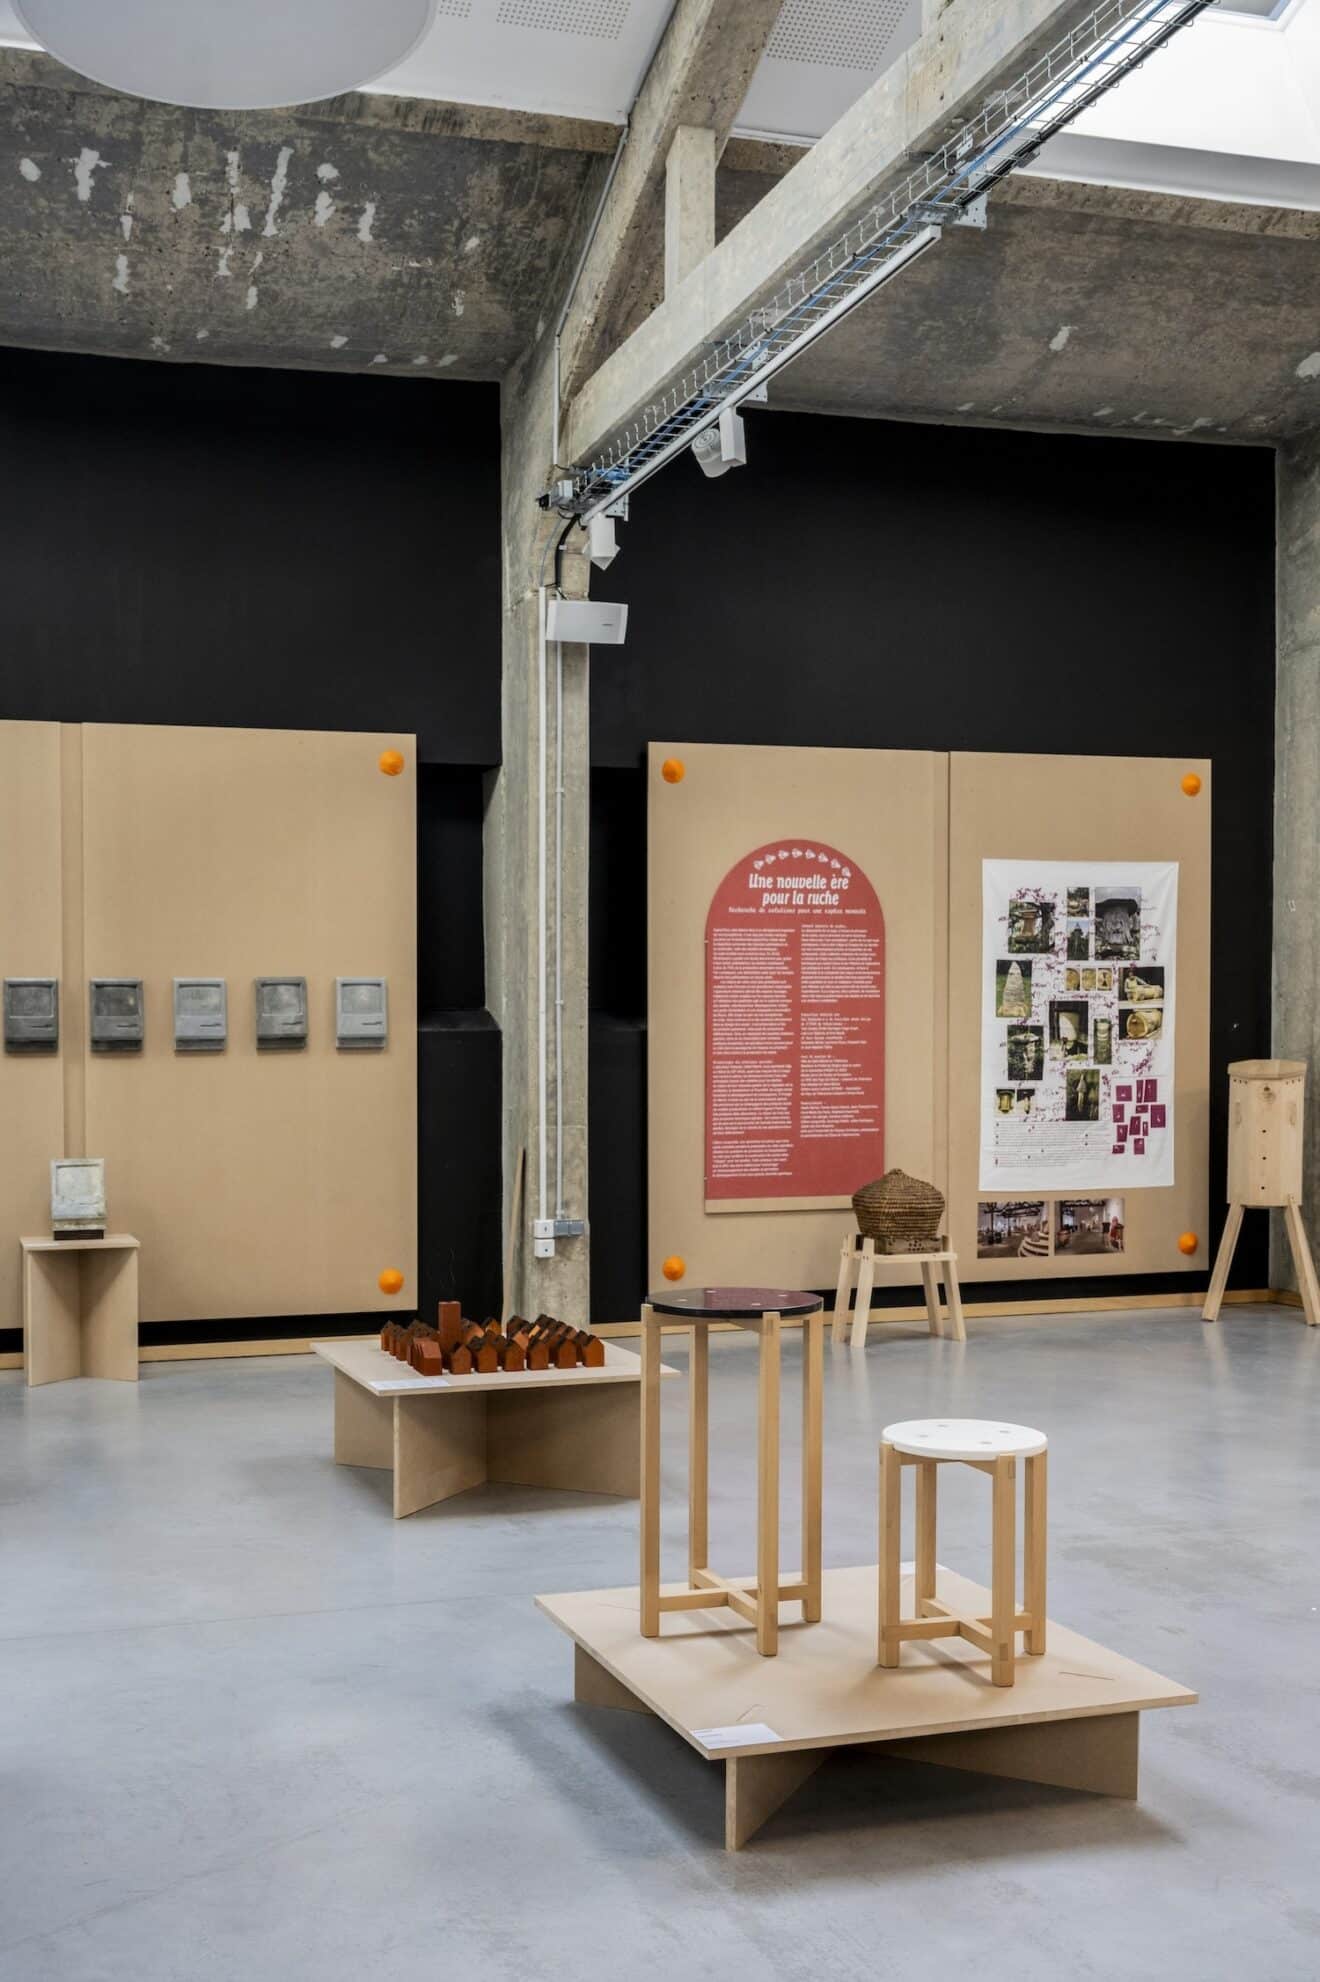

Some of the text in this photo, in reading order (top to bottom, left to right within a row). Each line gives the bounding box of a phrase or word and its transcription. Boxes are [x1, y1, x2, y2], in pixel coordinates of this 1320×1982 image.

[749, 873, 849, 890] Une nouvelle ère
[762, 890, 839, 907] pour la ruche
